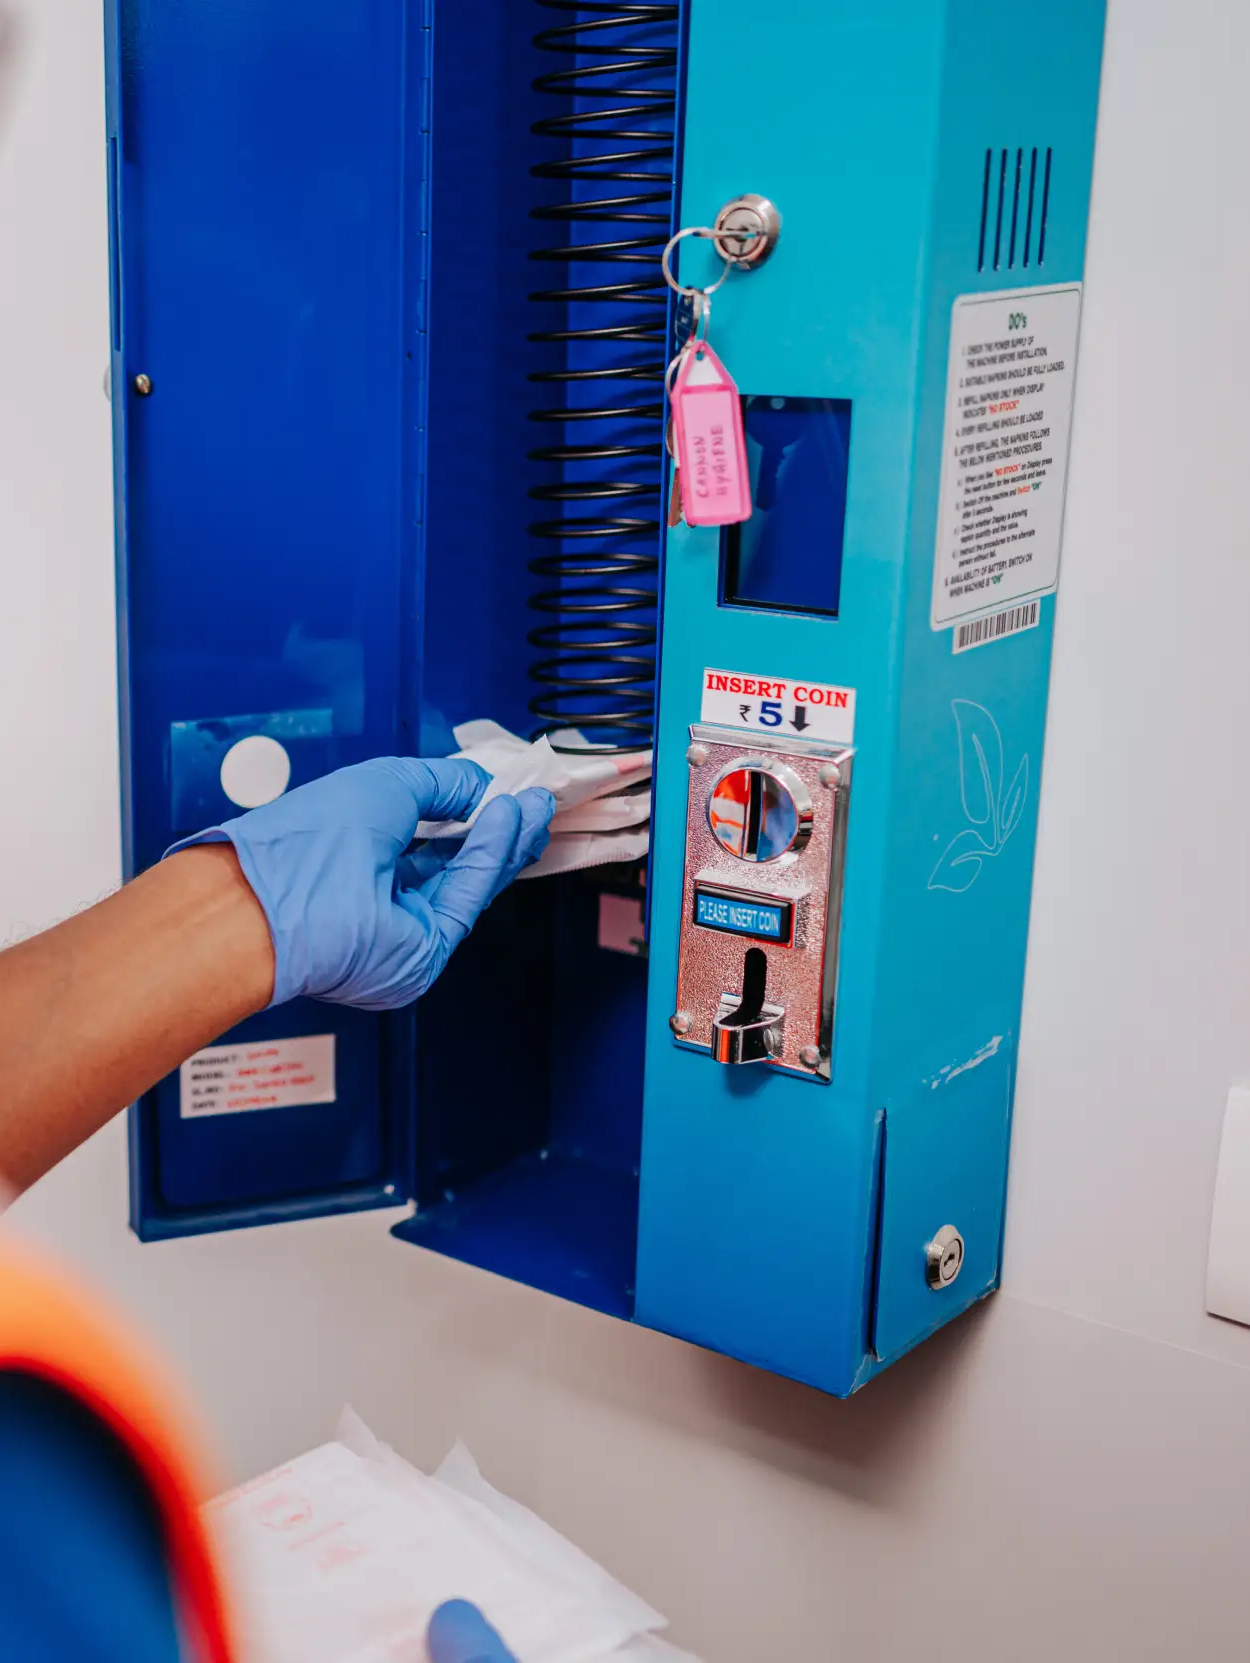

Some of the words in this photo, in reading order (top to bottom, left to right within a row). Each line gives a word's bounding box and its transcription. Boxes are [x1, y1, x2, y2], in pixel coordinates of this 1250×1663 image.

[994, 339, 1010, 351] POWER
[1011, 337, 1027, 349] SUPPLY
[976, 354, 998, 367] MACHINE
[998, 352, 1016, 363] BEFORE
[1008, 367, 1026, 380] SHOULD
[1026, 366, 1033, 376] BE
[1034, 364, 1046, 376] FULLY
[1026, 382, 1045, 394] DISPLAY
[1000, 416, 1019, 429] SHOULD
[1019, 414, 1026, 424] BE
[1000, 436, 1009, 446] THE
[986, 448, 1012, 463] MENTIONED
[992, 492, 1008, 500] machine
[992, 515, 1006, 524] Display
[1010, 508, 1028, 519] showing
[992, 526, 1000, 535] and
[980, 566, 988, 576] OF
[1008, 554, 1025, 568] SWITCH
[949, 586, 963, 598] WHEN
[964, 578, 985, 593] MACHINE
[706, 674, 786, 700] INSERT
[793, 686, 849, 709] COIN
[758, 701, 783, 727] 5
[699, 900, 729, 924] PLEASE
[729, 905, 758, 930] INSERT
[758, 910, 779, 933] COIN
